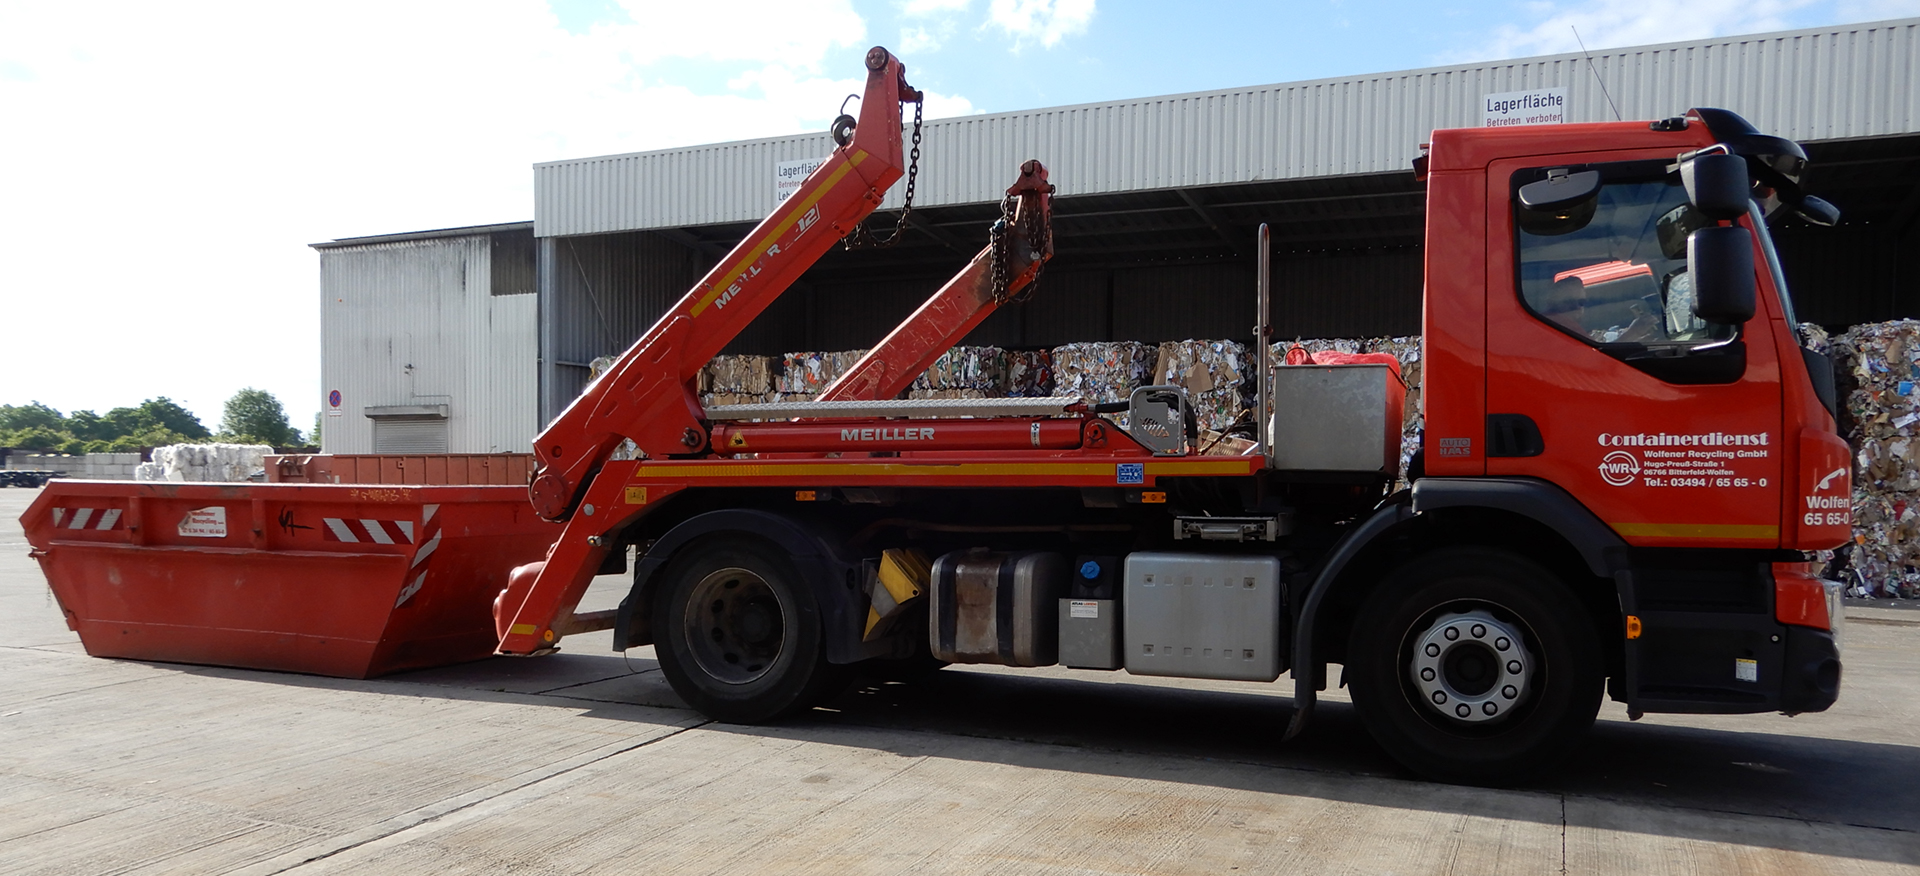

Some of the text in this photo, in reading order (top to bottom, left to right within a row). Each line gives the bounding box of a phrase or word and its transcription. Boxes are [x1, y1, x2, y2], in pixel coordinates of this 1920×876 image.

[1487, 93, 1563, 114] Lagerfläche
[1486, 113, 1562, 127] Betreten verboten
[778, 161, 820, 178] Lagerfläc
[840, 427, 935, 442] MEILLER
[1597, 432, 1769, 447] Containerdienst
[1441, 439, 1469, 447] AUTO
[1440, 447, 1470, 455] HAAS
[1643, 450, 1768, 459] Wolfener Recycling GmbH
[1608, 463, 1630, 474] WR
[1643, 460, 1718, 468] Hugo-Preuß-Straße
[1668, 468, 1734, 476] Bitterfeld-Wolfen
[1643, 477, 1668, 487] Tel.:
[1670, 477, 1706, 487] 03494
[1716, 478, 1731, 487] 65
[1733, 478, 1749, 487] 65
[1758, 478, 1767, 487] 0
[1805, 495, 1850, 509] Wolfen
[1804, 512, 1850, 526] 65 65-0
